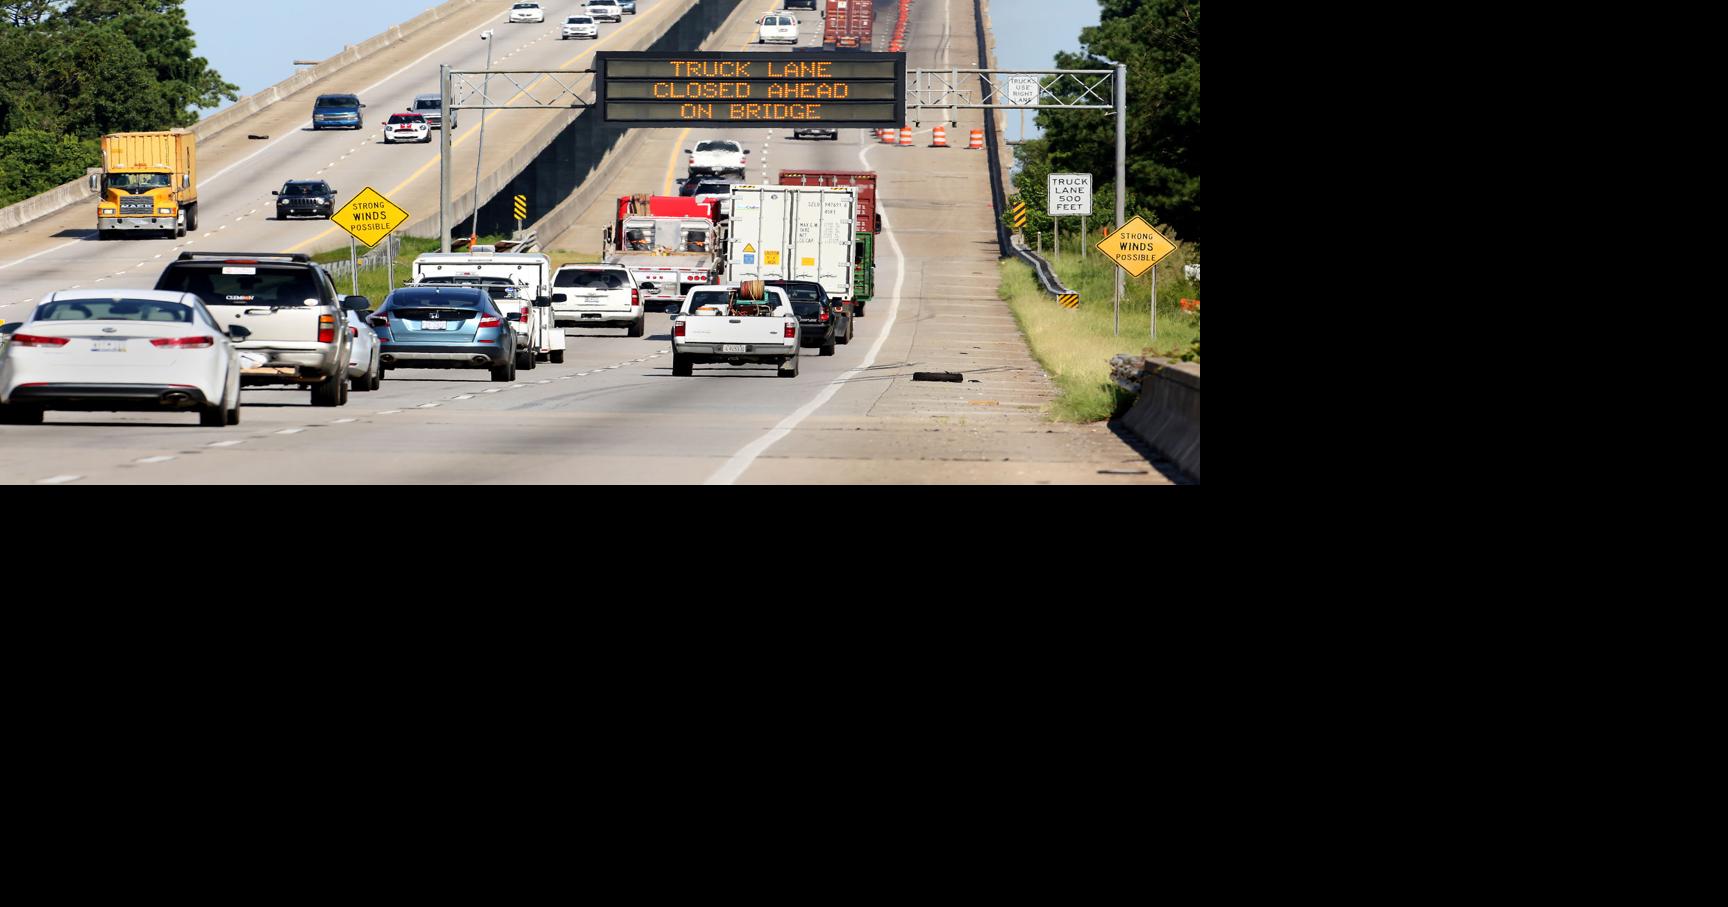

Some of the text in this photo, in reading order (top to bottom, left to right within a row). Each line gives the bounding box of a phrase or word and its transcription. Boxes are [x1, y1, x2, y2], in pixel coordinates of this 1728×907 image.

[669, 61, 832, 77] TRUCK LANE
[653, 82, 848, 98] CLOSED AHEAD
[681, 103, 822, 119] ON BRIDGE
[1052, 178, 1088, 186] TRUCK
[352, 202, 385, 211] STRONG
[353, 211, 387, 221] WINDS
[350, 223, 390, 232] POSSIBLE
[1120, 232, 1153, 240] STRONG
[1119, 242, 1154, 251] WINDS
[1115, 253, 1156, 261] POSSIBLE
